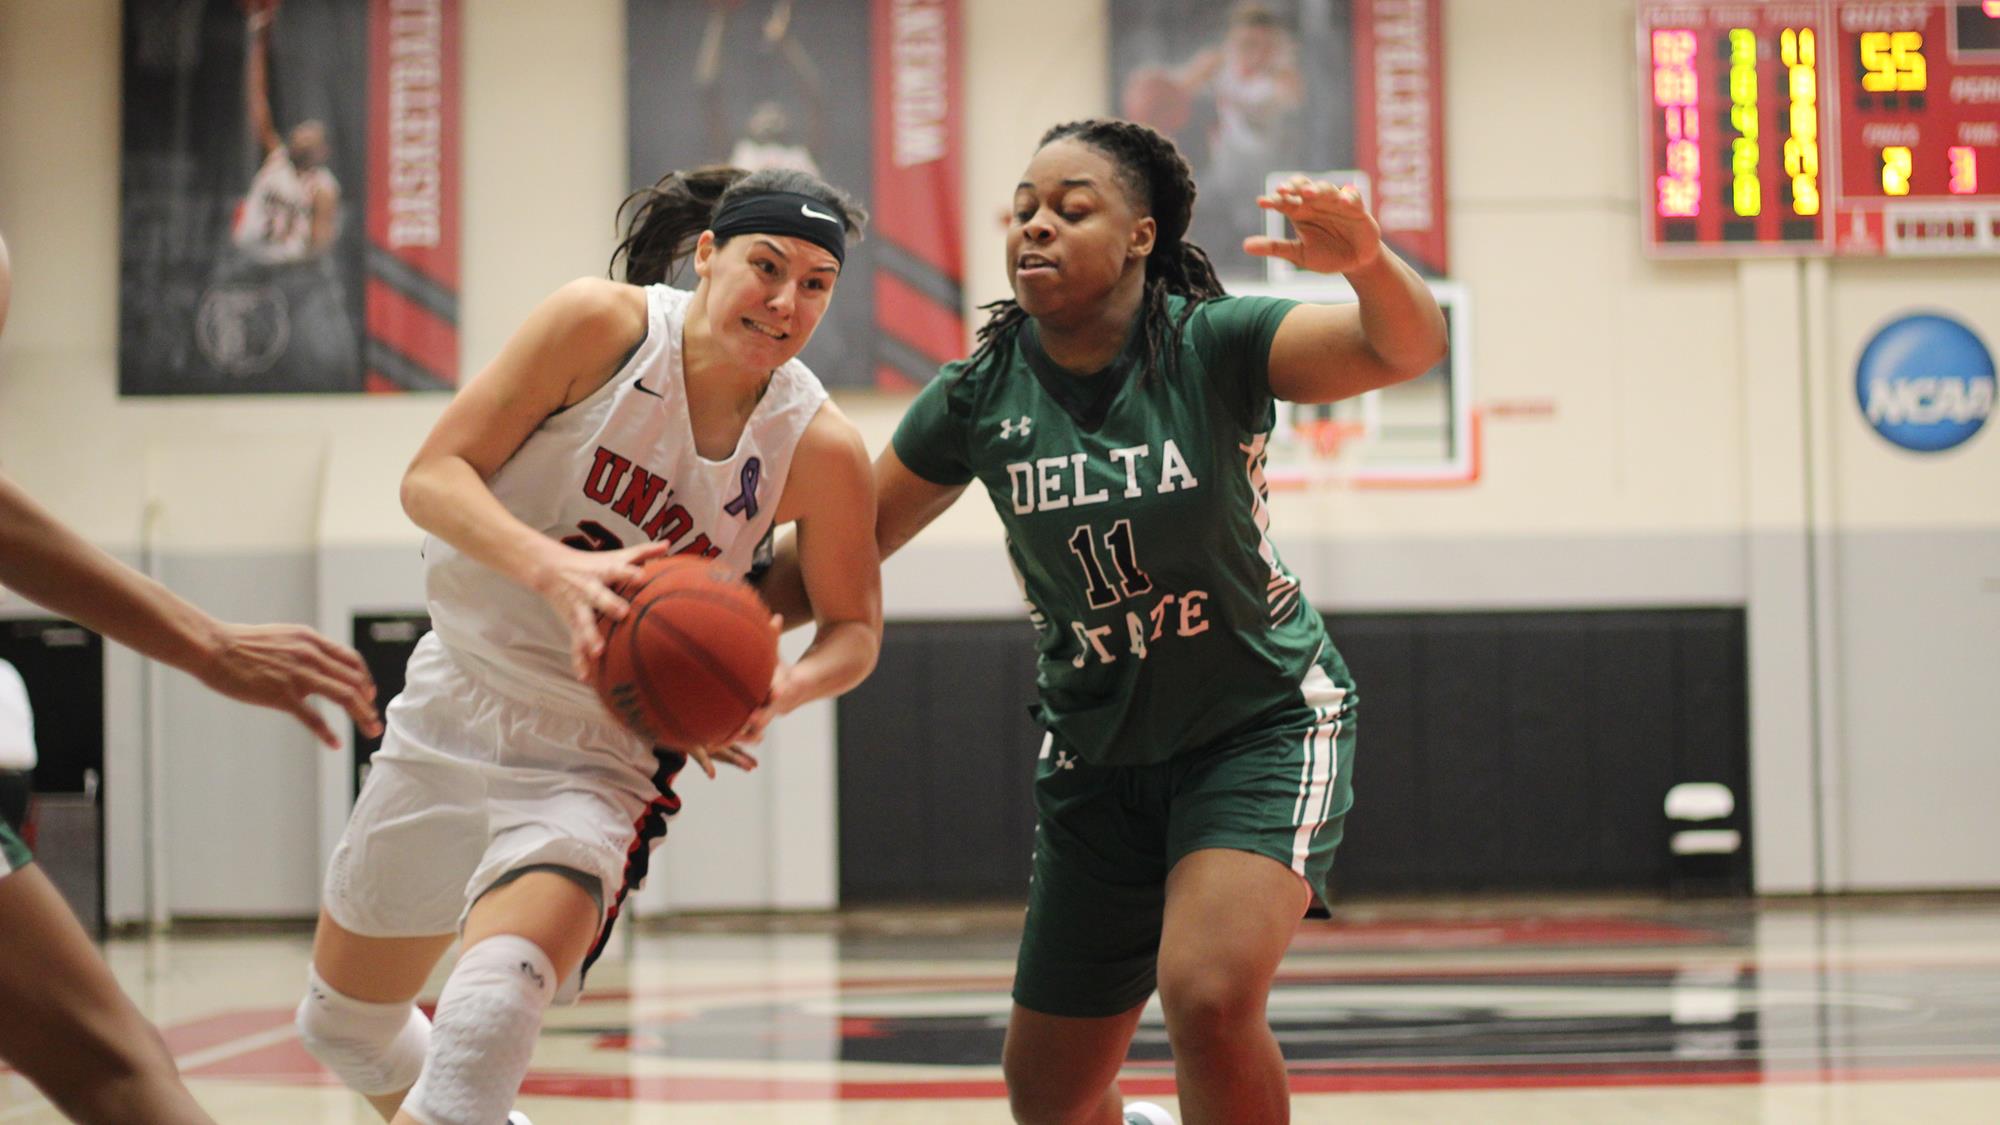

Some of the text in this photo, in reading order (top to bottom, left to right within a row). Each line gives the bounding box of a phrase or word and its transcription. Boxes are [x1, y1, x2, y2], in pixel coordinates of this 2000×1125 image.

[1860, 31, 1927, 92] 55
[1866, 376, 1994, 427] NCAA
[1006, 438, 1199, 516] DELTA
[1068, 518, 1153, 611] 11
